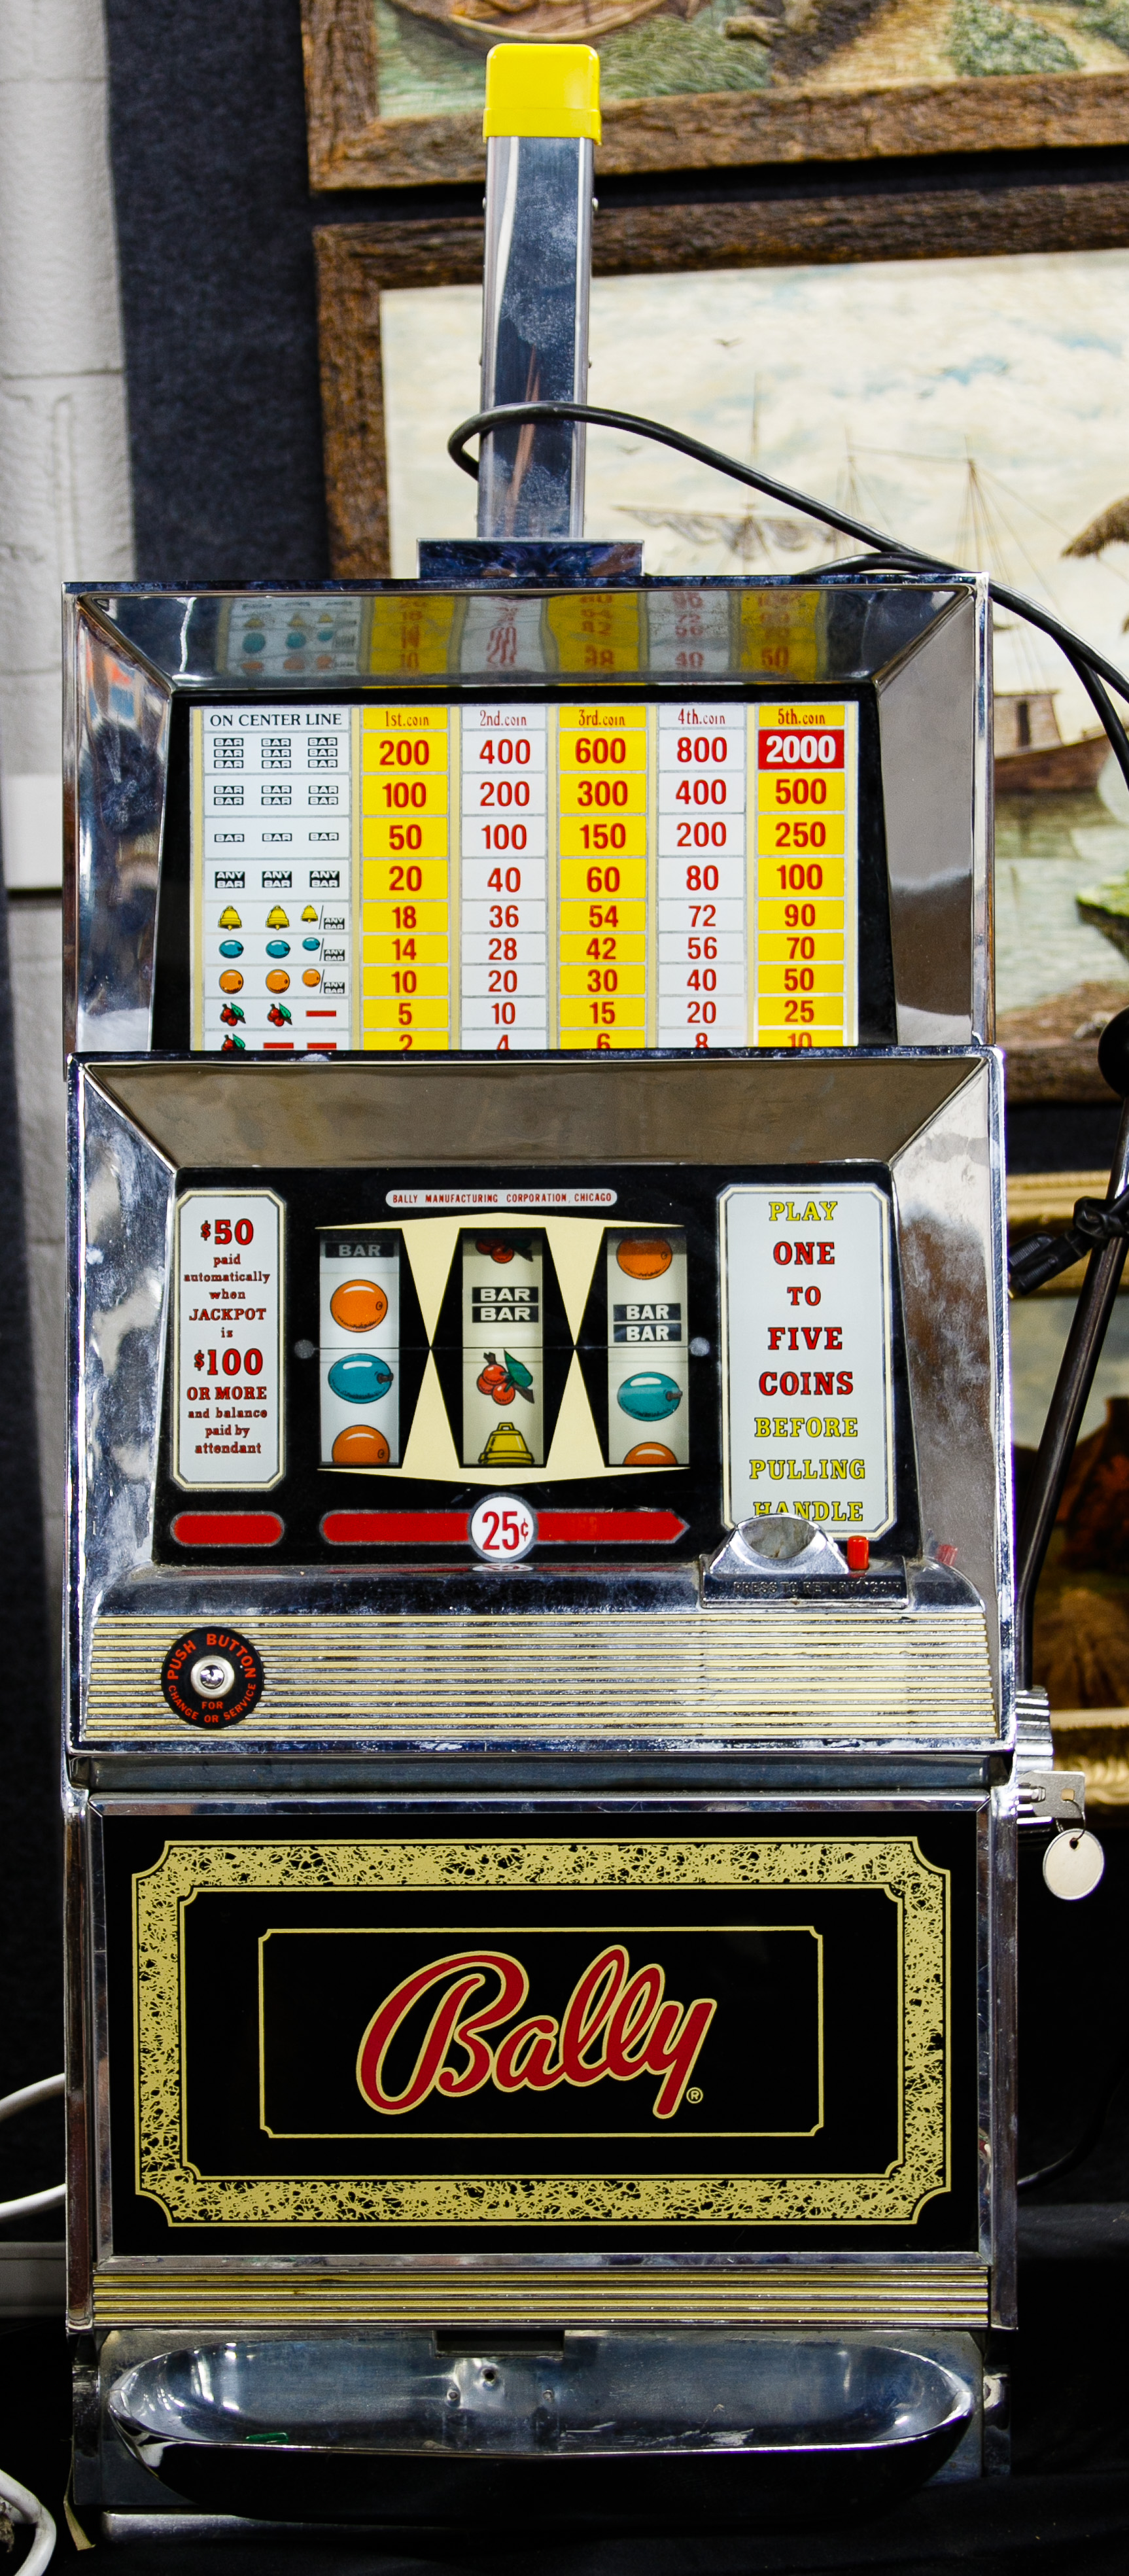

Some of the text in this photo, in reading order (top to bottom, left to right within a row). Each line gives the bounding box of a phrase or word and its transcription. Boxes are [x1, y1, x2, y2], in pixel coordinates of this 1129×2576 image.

[211, 714, 341, 726] ON CENTER LINE
[386, 711, 428, 726] 1st.coin
[480, 710, 526, 725] 2nd.coin
[579, 710, 625, 725] 3rd.coin
[678, 708, 725, 724] 4th.coin
[778, 708, 825, 724] 5th.coin
[380, 740, 429, 765] 200
[479, 739, 530, 764] 400
[576, 738, 626, 763] 600
[677, 737, 727, 763] 800
[767, 736, 835, 763] 2000
[383, 782, 426, 808] 100
[480, 781, 529, 807] 200
[578, 780, 628, 807] 300
[676, 779, 726, 805] 400
[776, 778, 826, 805] 500
[389, 824, 422, 850] 50
[481, 824, 527, 850] 100
[580, 823, 625, 849] 150
[677, 822, 726, 847] 200
[776, 822, 825, 847] 250
[389, 866, 422, 892] 20
[487, 867, 521, 892] 40
[587, 867, 620, 892] 60
[686, 865, 718, 890] 80
[777, 864, 822, 890] 100
[392, 905, 417, 929] 18
[489, 905, 519, 928] 36
[589, 905, 618, 928] 54
[689, 905, 716, 927] 72
[785, 904, 815, 927] 90
[392, 938, 417, 960] 14
[489, 938, 517, 960] 28
[586, 937, 616, 960] 42
[688, 937, 717, 959] 56
[787, 937, 814, 960] 70
[391, 970, 417, 994] 10
[489, 970, 517, 992] 20
[587, 969, 617, 992] 30
[687, 969, 716, 991] 40
[784, 967, 814, 991] 50
[399, 1003, 412, 1025] 5
[492, 1002, 515, 1024] 10
[590, 1001, 616, 1024] 15
[687, 1001, 716, 1024] 20
[784, 1000, 814, 1022] 25
[393, 1194, 417, 1203] BALLY
[574, 1192, 612, 1202] CHICAGO
[769, 1201, 837, 1221] PLAY
[201, 1219, 254, 1245] $50
[214, 1253, 241, 1268] paid
[339, 1244, 381, 1257] BAR
[773, 1242, 835, 1265] ONE
[184, 1271, 270, 1283] automatically
[209, 1289, 245, 1299] when
[481, 1289, 529, 1301] BAR
[787, 1286, 821, 1306] TO
[189, 1308, 266, 1321] JACKPOT
[481, 1308, 530, 1320] BAR
[627, 1305, 669, 1319] BAR
[221, 1327, 233, 1338] is
[627, 1325, 669, 1341] BAR
[768, 1327, 842, 1350] FIVE
[194, 1348, 263, 1376] $100
[187, 1386, 267, 1401] OR MORE
[759, 1371, 853, 1396] COINS
[188, 1407, 268, 1418] and balance
[205, 1424, 250, 1438] paid by
[754, 1417, 858, 1437] BEFORE
[195, 1441, 261, 1453] attendant
[749, 1459, 865, 1480] PULLING
[483, 1511, 528, 1550] 25¢
[733, 1581, 777, 1593] PRESS
[780, 1581, 799, 1593] TO
[167, 1633, 256, 1680] PUSH BUTTON
[168, 1683, 256, 1723] CHANGE OR SERVICE
[356, 1944, 717, 2119] Bally
